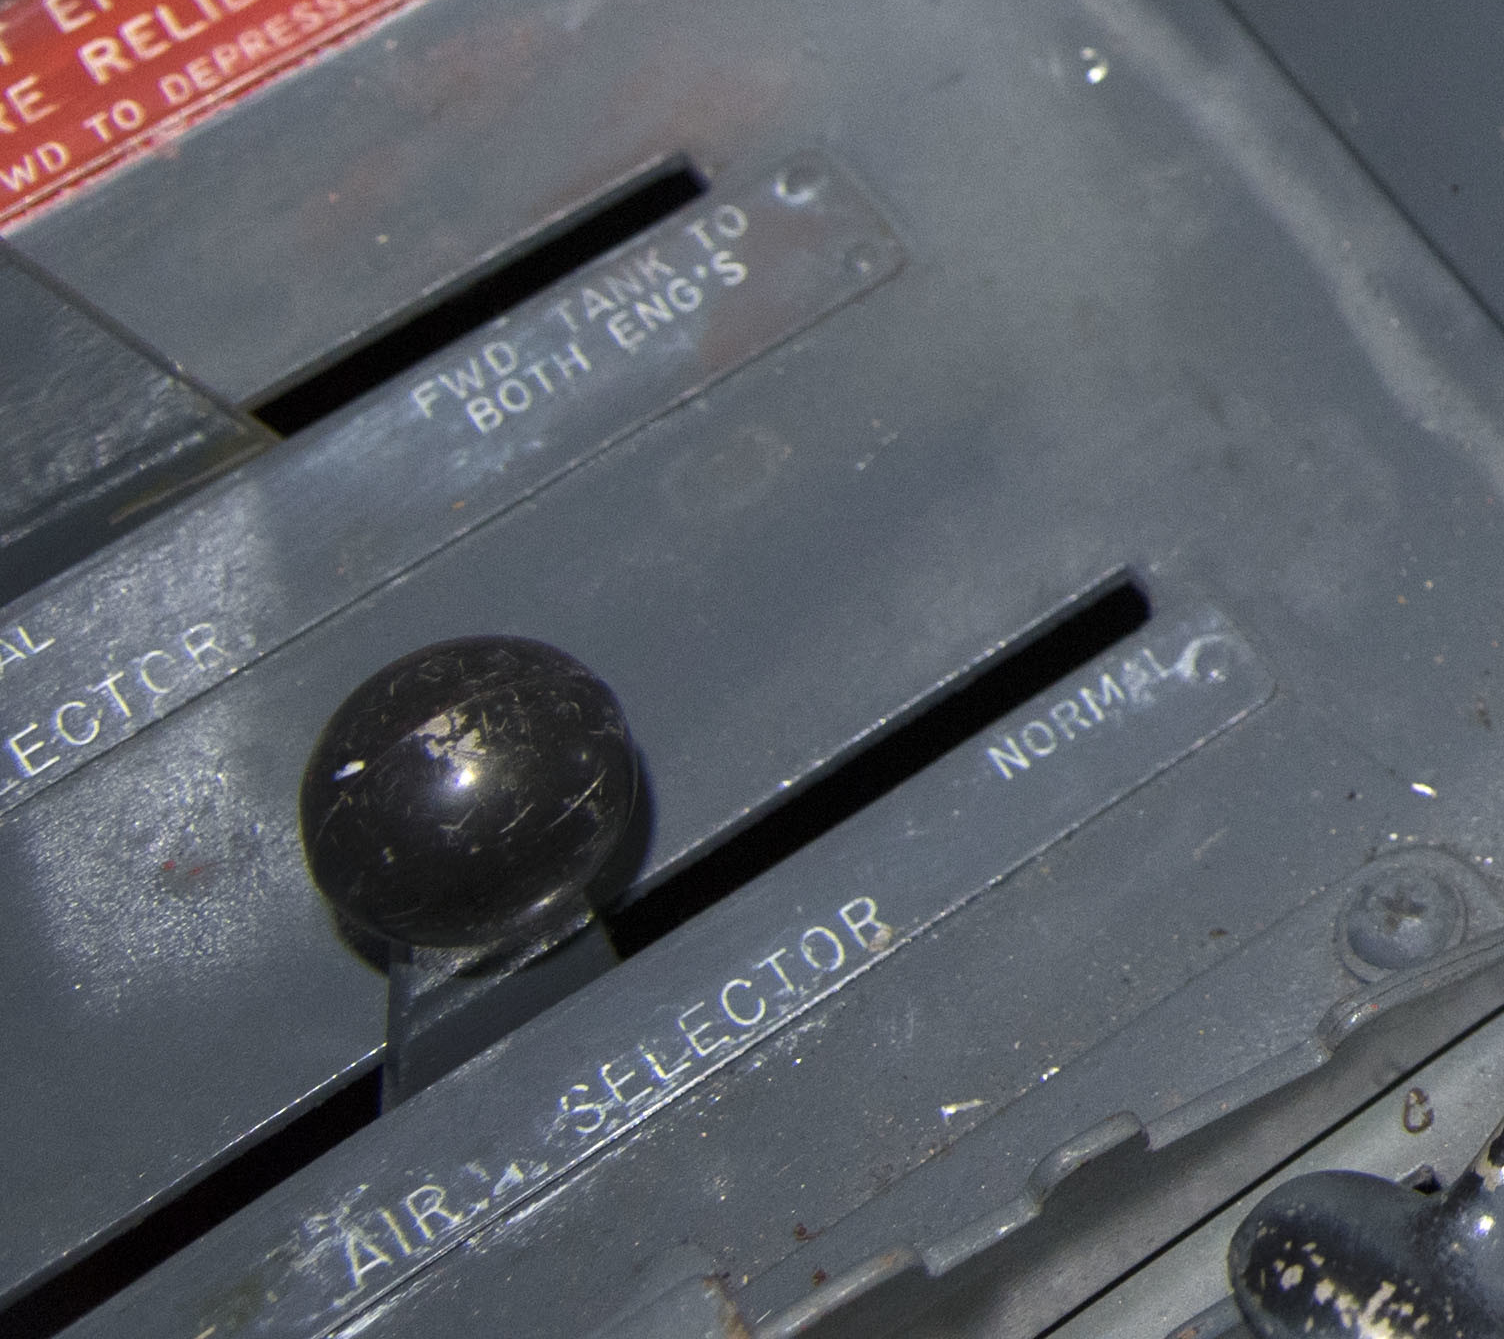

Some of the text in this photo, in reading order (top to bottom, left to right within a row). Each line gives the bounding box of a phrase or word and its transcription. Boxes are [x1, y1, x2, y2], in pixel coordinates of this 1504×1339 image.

[82, 98, 146, 144] TO
[411, 204, 748, 419] FWD TANK TO
[466, 341, 592, 434] BOTH
[340, 895, 894, 1289] AIR SELECTOR
